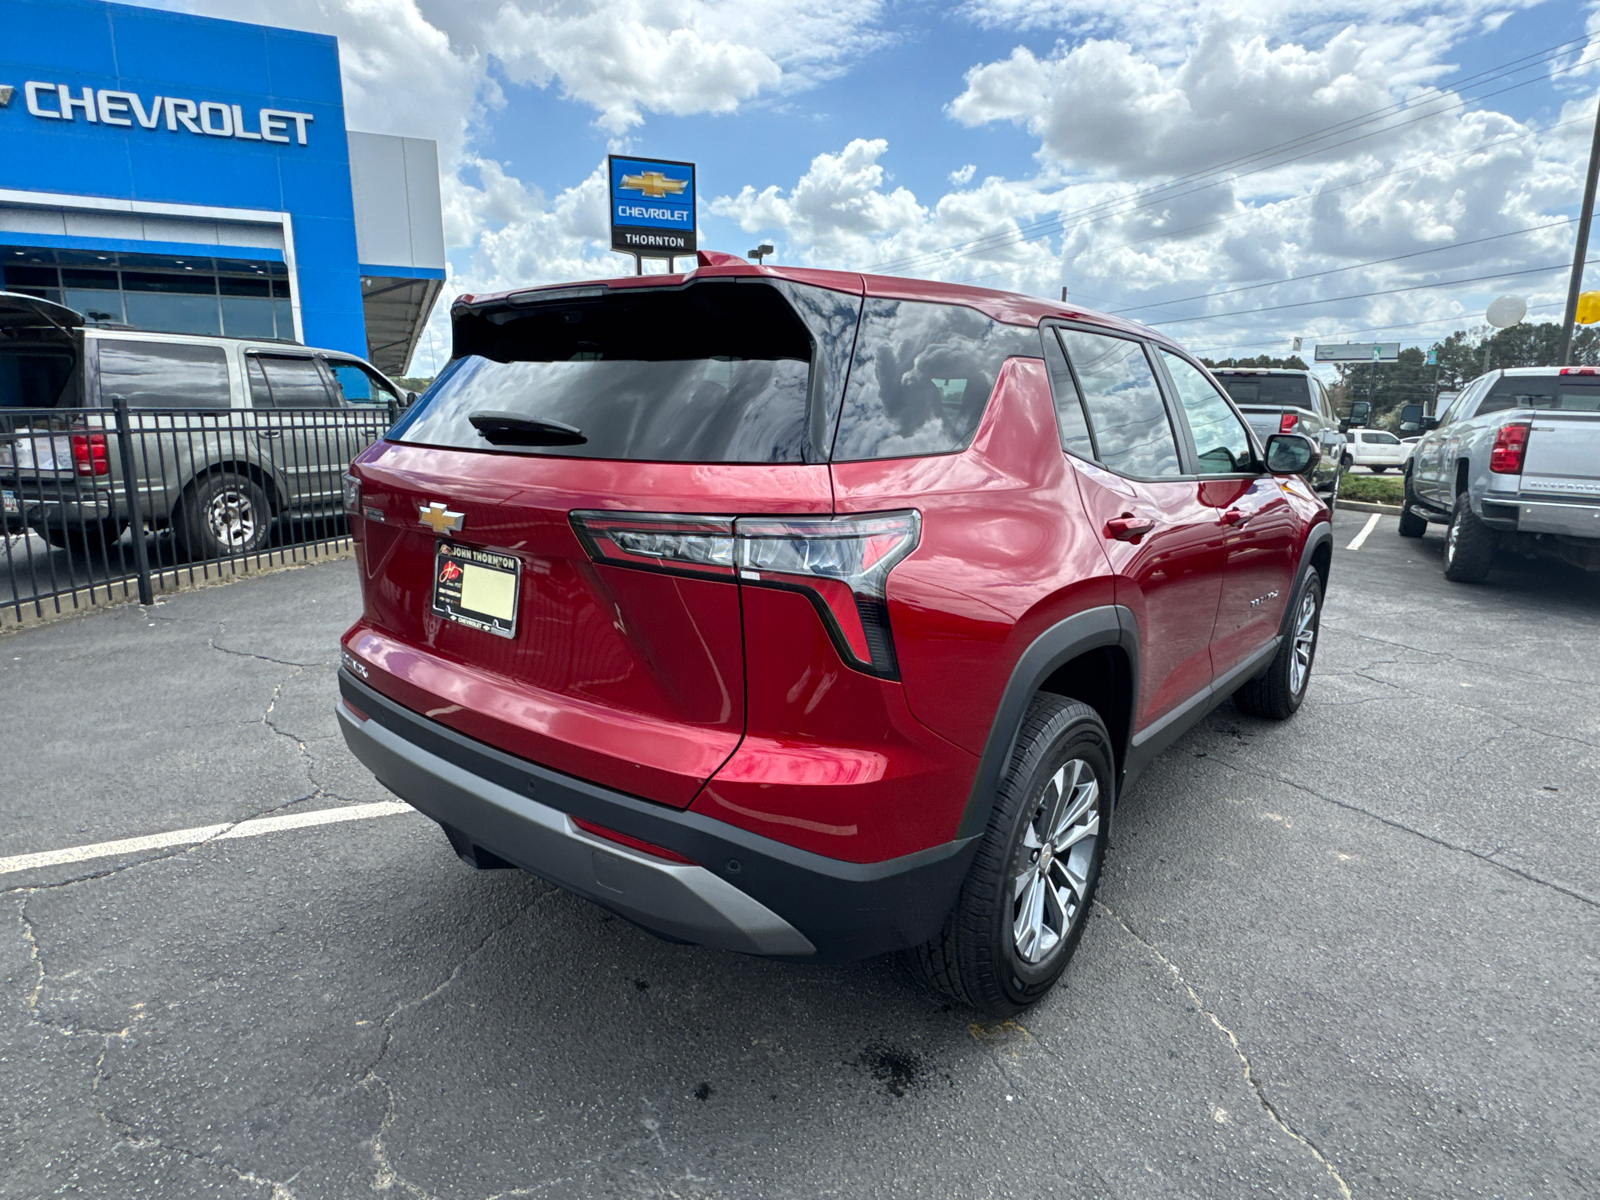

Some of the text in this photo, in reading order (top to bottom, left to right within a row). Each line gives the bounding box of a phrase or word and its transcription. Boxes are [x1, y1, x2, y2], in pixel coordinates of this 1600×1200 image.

[24, 80, 314, 145] CHEVROLET
[618, 205, 689, 222] CHEVROLET
[625, 233, 684, 247] THORNTON
[453, 547, 515, 569] JOHN THORNTON
[457, 617, 483, 629] CHEVROLET
